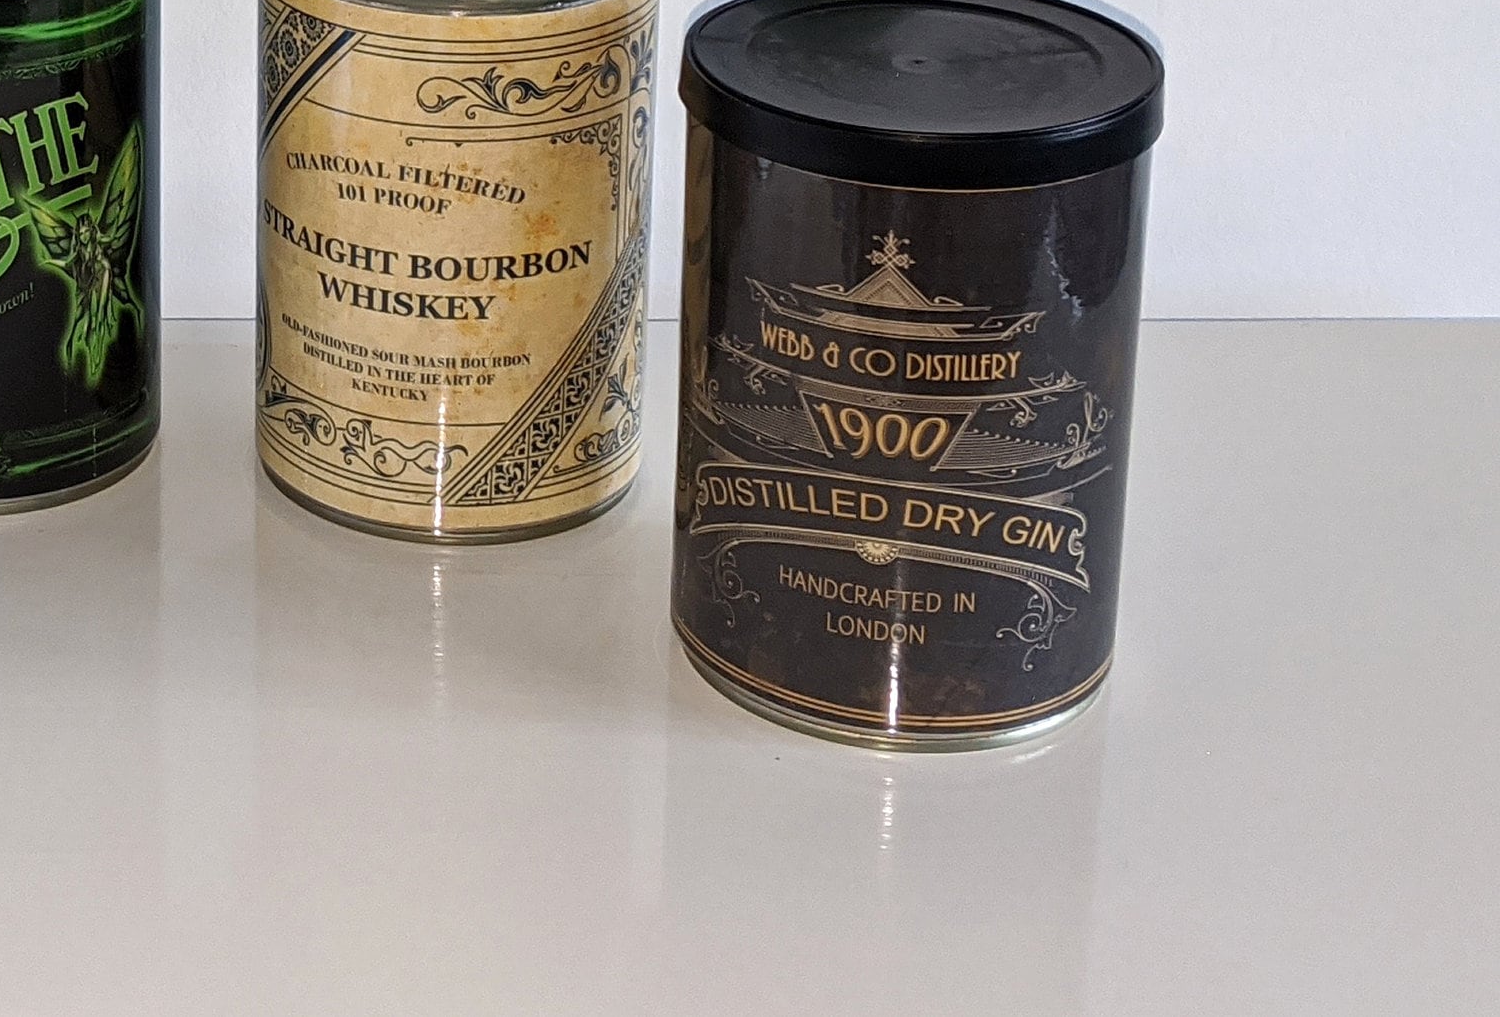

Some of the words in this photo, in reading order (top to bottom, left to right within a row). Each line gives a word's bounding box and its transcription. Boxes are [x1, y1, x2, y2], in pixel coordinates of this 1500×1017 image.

[286, 151, 391, 180] CHARCOAL
[398, 163, 526, 206] FILTERED
[336, 182, 367, 202] 101
[373, 186, 452, 215] PROOF
[263, 198, 399, 276] STRAIGHT
[407, 240, 593, 281] BOURBON
[317, 270, 497, 322] WHISKEY
[281, 312, 369, 358] OLD-FASHIONED
[371, 348, 409, 365] SOUR
[412, 354, 456, 369] MASH
[460, 352, 531, 369] BOURBON
[303, 341, 364, 374] DISTILLED
[367, 363, 382, 378] IN
[385, 368, 416, 384] THE
[419, 373, 473, 387] HEART
[476, 373, 496, 386] OF
[760, 320, 815, 361] WEBB
[823, 341, 840, 369] &
[849, 347, 896, 377] CO
[905, 350, 1021, 382] DISTILLERY
[351, 378, 429, 402] KENTUCKY
[812, 402, 950, 461] 1900
[710, 476, 890, 523] DISTILLED
[903, 499, 998, 537] DRY
[1002, 514, 1066, 554] GIN
[778, 563, 942, 614] HANDCRAFTED
[953, 592, 976, 613] IN
[826, 611, 926, 645] LONDON
